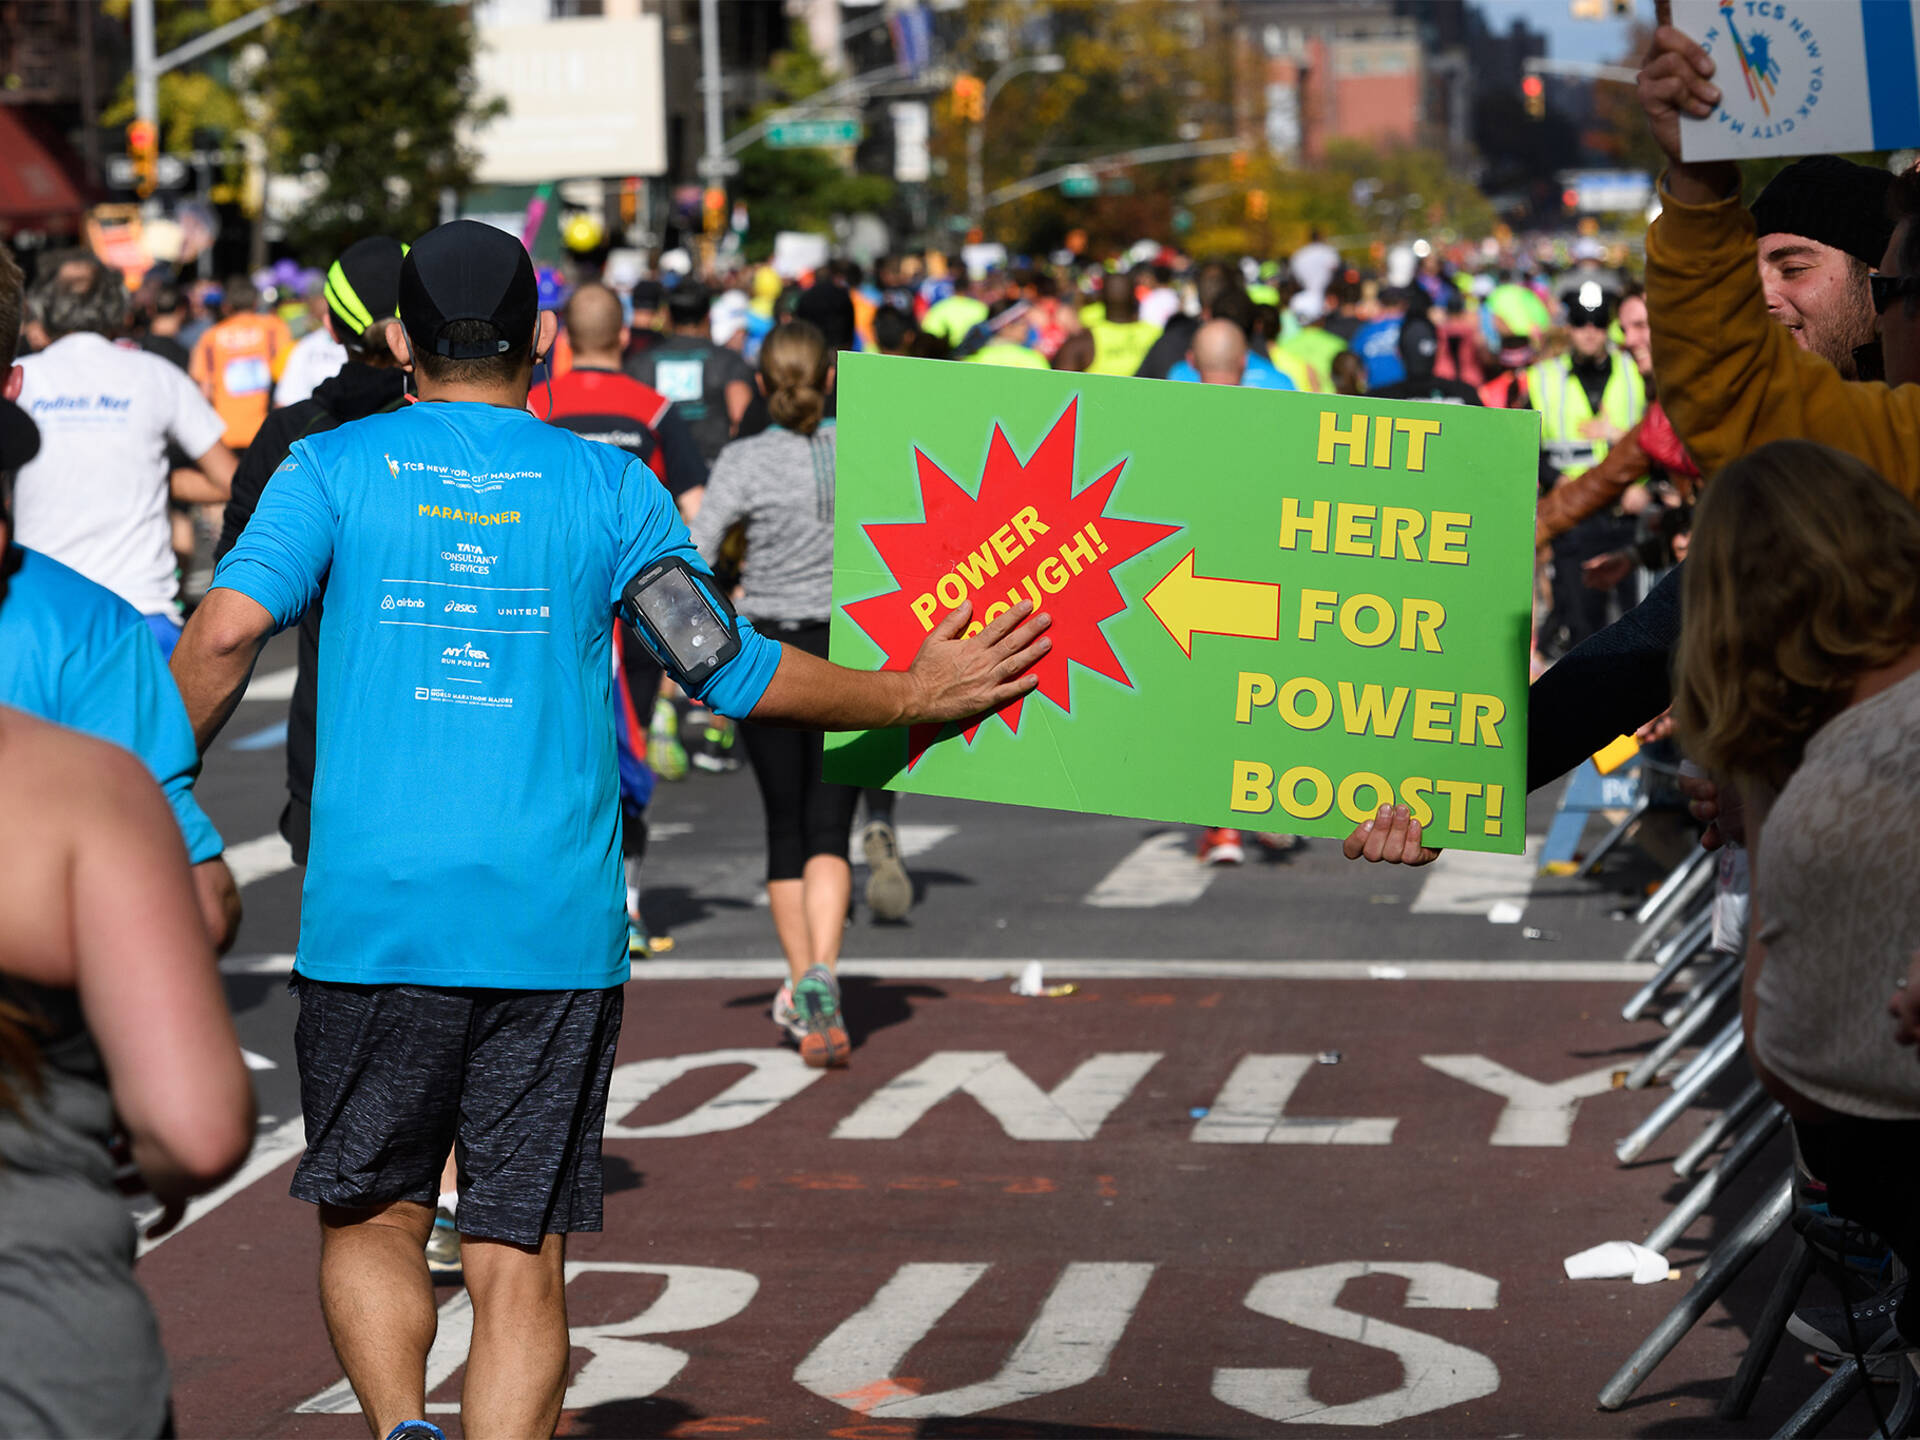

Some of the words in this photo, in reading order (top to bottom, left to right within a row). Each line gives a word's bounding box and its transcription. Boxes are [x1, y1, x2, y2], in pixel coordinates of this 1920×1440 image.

[1745, 1, 1786, 20] TCS
[1789, 18, 1821, 59] NEW
[1798, 66, 1824, 118] YORK
[1752, 119, 1795, 138] CITY
[1317, 411, 1441, 472] HIT
[403, 462, 424, 471] TCS
[427, 465, 449, 474] NEW
[490, 471, 542, 480] MARATHON
[418, 504, 520, 526] MARATHONER
[1279, 497, 1472, 566] HERE
[441, 552, 498, 565] CONSULTANCY
[457, 543, 483, 554] TATA
[450, 563, 489, 575] SERVICES
[909, 505, 1051, 632] POWER
[397, 598, 425, 608] airbnb
[498, 608, 538, 616] UNITED
[1298, 588, 1446, 654] FOR
[474, 661, 490, 669] LIFE
[453, 693, 487, 701] MARATHON
[1235, 671, 1506, 748] POWER
[1230, 759, 1503, 837] BOOST!
[602, 1048, 1690, 1146] ONLY
[295, 1261, 1500, 1425] BUS
